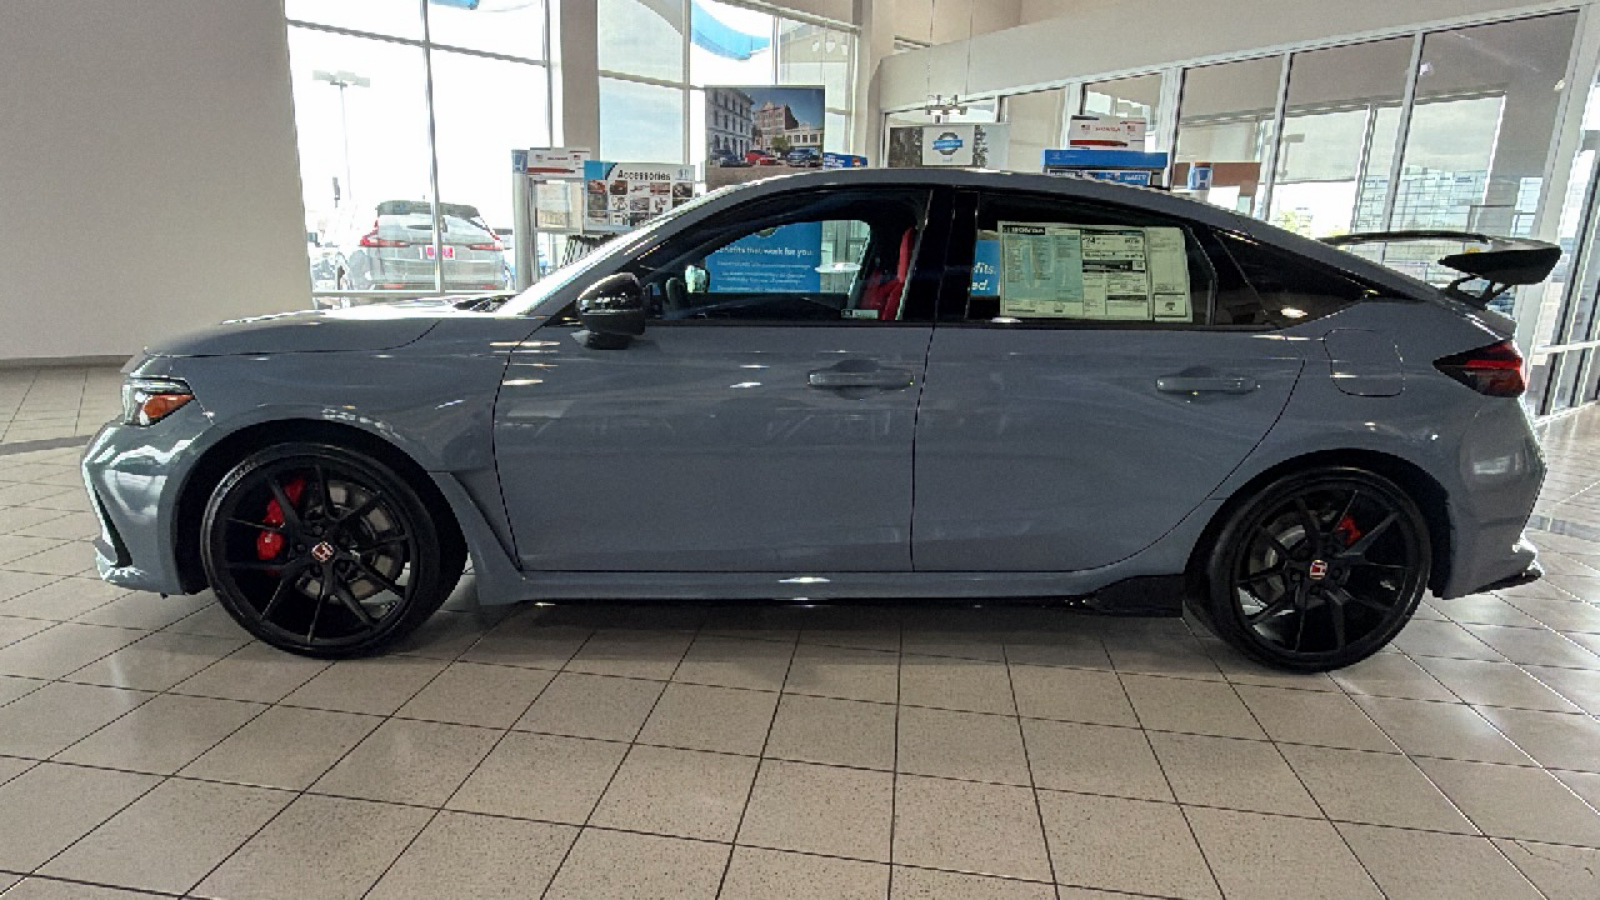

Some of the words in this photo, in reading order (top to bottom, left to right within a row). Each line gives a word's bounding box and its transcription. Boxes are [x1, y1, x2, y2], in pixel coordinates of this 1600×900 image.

[617, 169, 671, 181] Accessories
[764, 247, 782, 255] work
[784, 247, 796, 256] for
